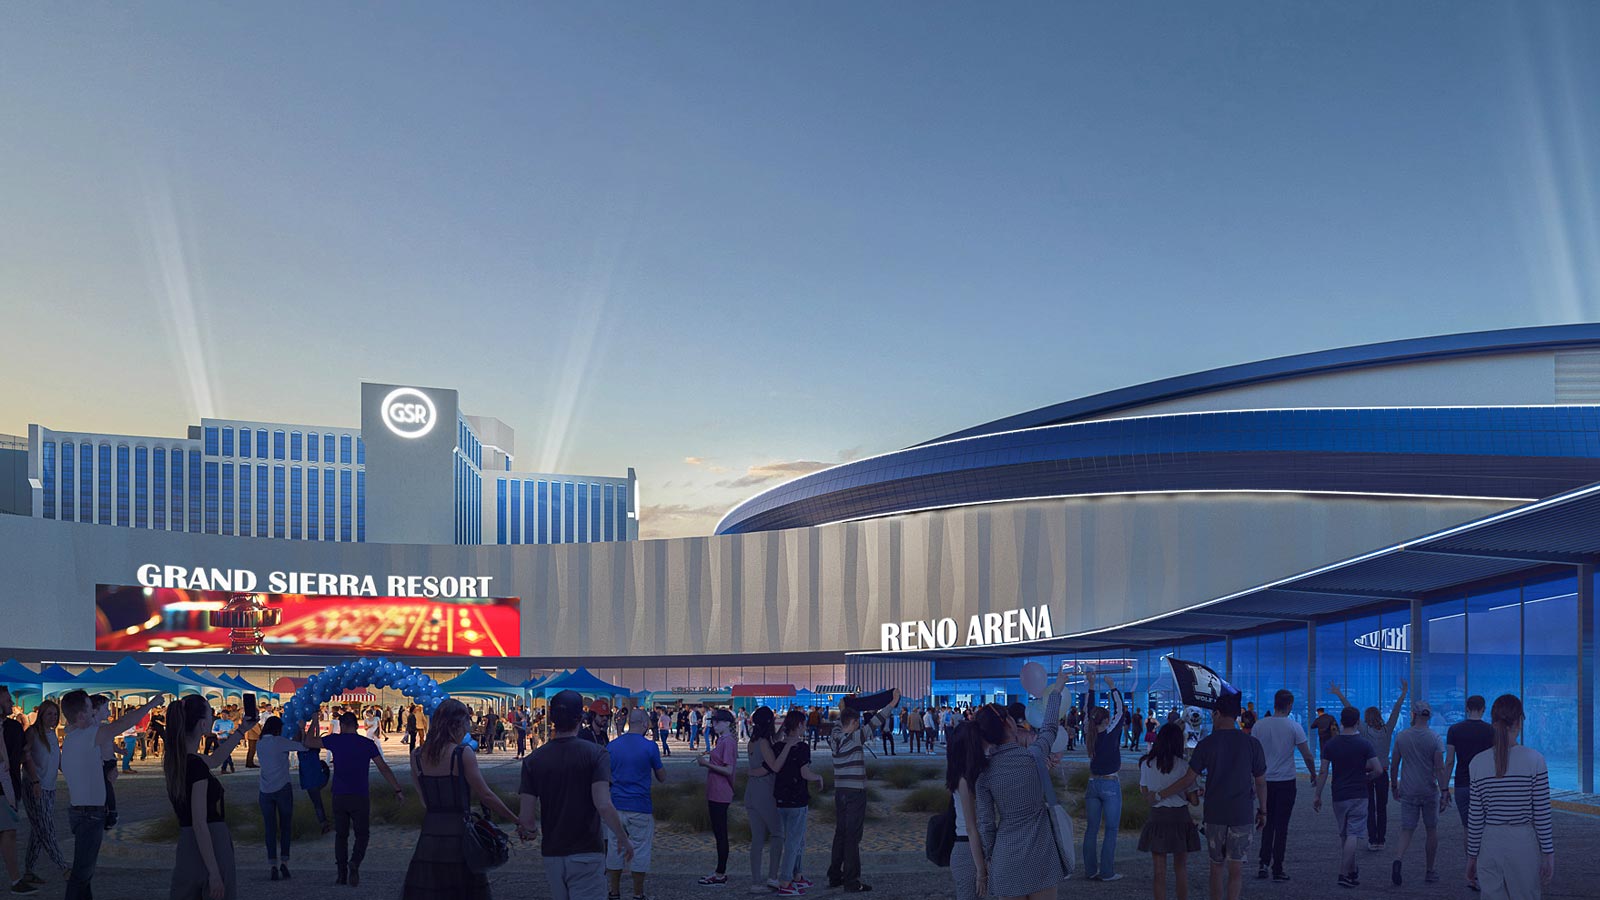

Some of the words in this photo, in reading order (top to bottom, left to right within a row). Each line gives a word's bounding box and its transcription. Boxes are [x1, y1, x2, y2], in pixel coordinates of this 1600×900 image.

[390, 402, 427, 424] GSR
[136, 564, 257, 591] GRAND
[268, 571, 377, 596] SIERRA
[387, 575, 493, 598] RESORT
[881, 617, 958, 651] RENO
[966, 604, 1053, 646] ARENA
